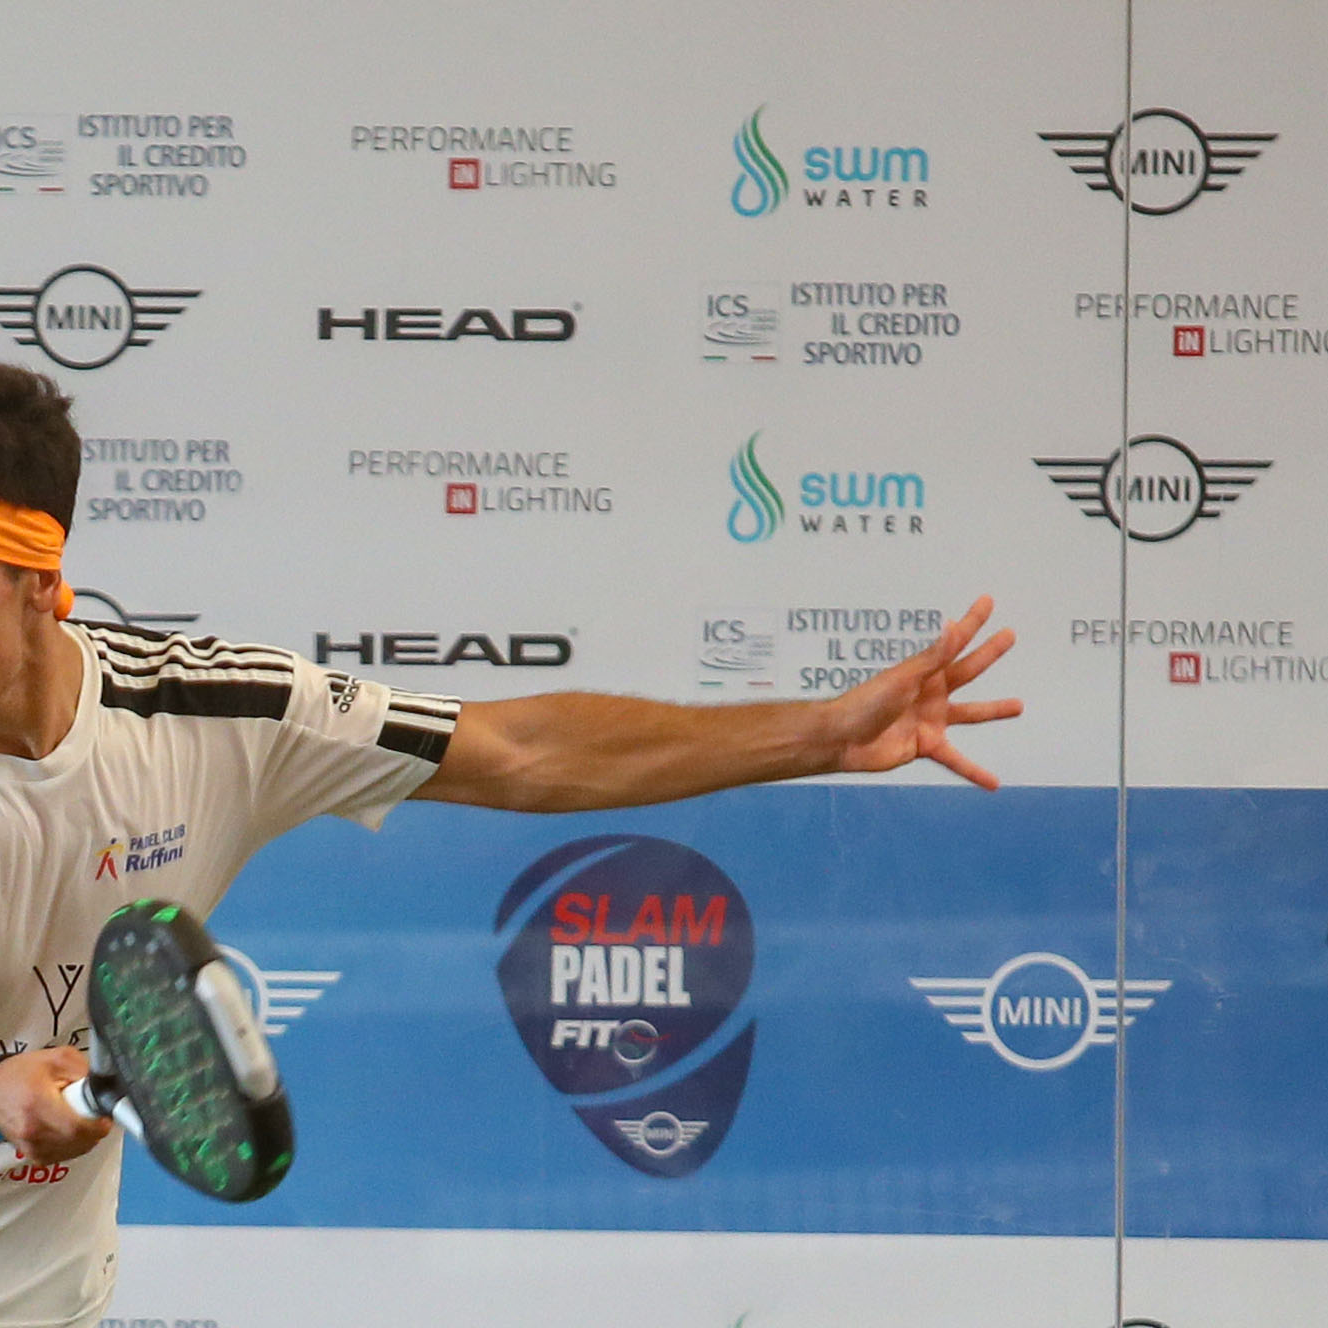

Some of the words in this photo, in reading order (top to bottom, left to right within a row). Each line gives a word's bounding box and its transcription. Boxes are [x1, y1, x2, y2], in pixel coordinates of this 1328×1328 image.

[78, 115, 182, 138] ISTITUTO
[188, 116, 233, 139] PER
[352, 126, 573, 151] PERFORMANCE
[118, 145, 138, 167] IL
[143, 145, 246, 168] CREDITO
[91, 173, 208, 197] SPORTIVO
[484, 163, 616, 188] LIGHTING
[805, 190, 928, 207] WATER
[707, 295, 749, 316] ICS
[791, 283, 895, 306] ISTITUTO
[903, 284, 946, 307] PER
[46, 307, 123, 331] MINI
[319, 308, 575, 341] HEAD
[832, 313, 853, 334] IL
[858, 313, 960, 336] CREDITO
[804, 342, 922, 365] SPORTIVO
[81, 440, 178, 463] STITUTO
[184, 440, 230, 463] PER
[349, 451, 569, 477] PERFORMANCE
[116, 470, 136, 491] IL
[141, 470, 242, 492] CREDITO
[88, 498, 205, 521] SPORTIVO
[481, 488, 612, 512] LIGHTING
[801, 515, 924, 533] WATER
[703, 621, 745, 641] ICS
[788, 609, 892, 631] ISTITUTO
[899, 610, 942, 631] PER
[315, 633, 572, 666] HEAD
[828, 638, 846, 660] IL
[854, 639, 935, 661] CREDI
[800, 668, 878, 690] SPORT
[125, 845, 183, 872] Ruffini
[549, 892, 728, 946] SLAM
[550, 945, 692, 1007] PADEL
[1000, 995, 1084, 1029] MINI
[550, 1020, 621, 1049] FIT
